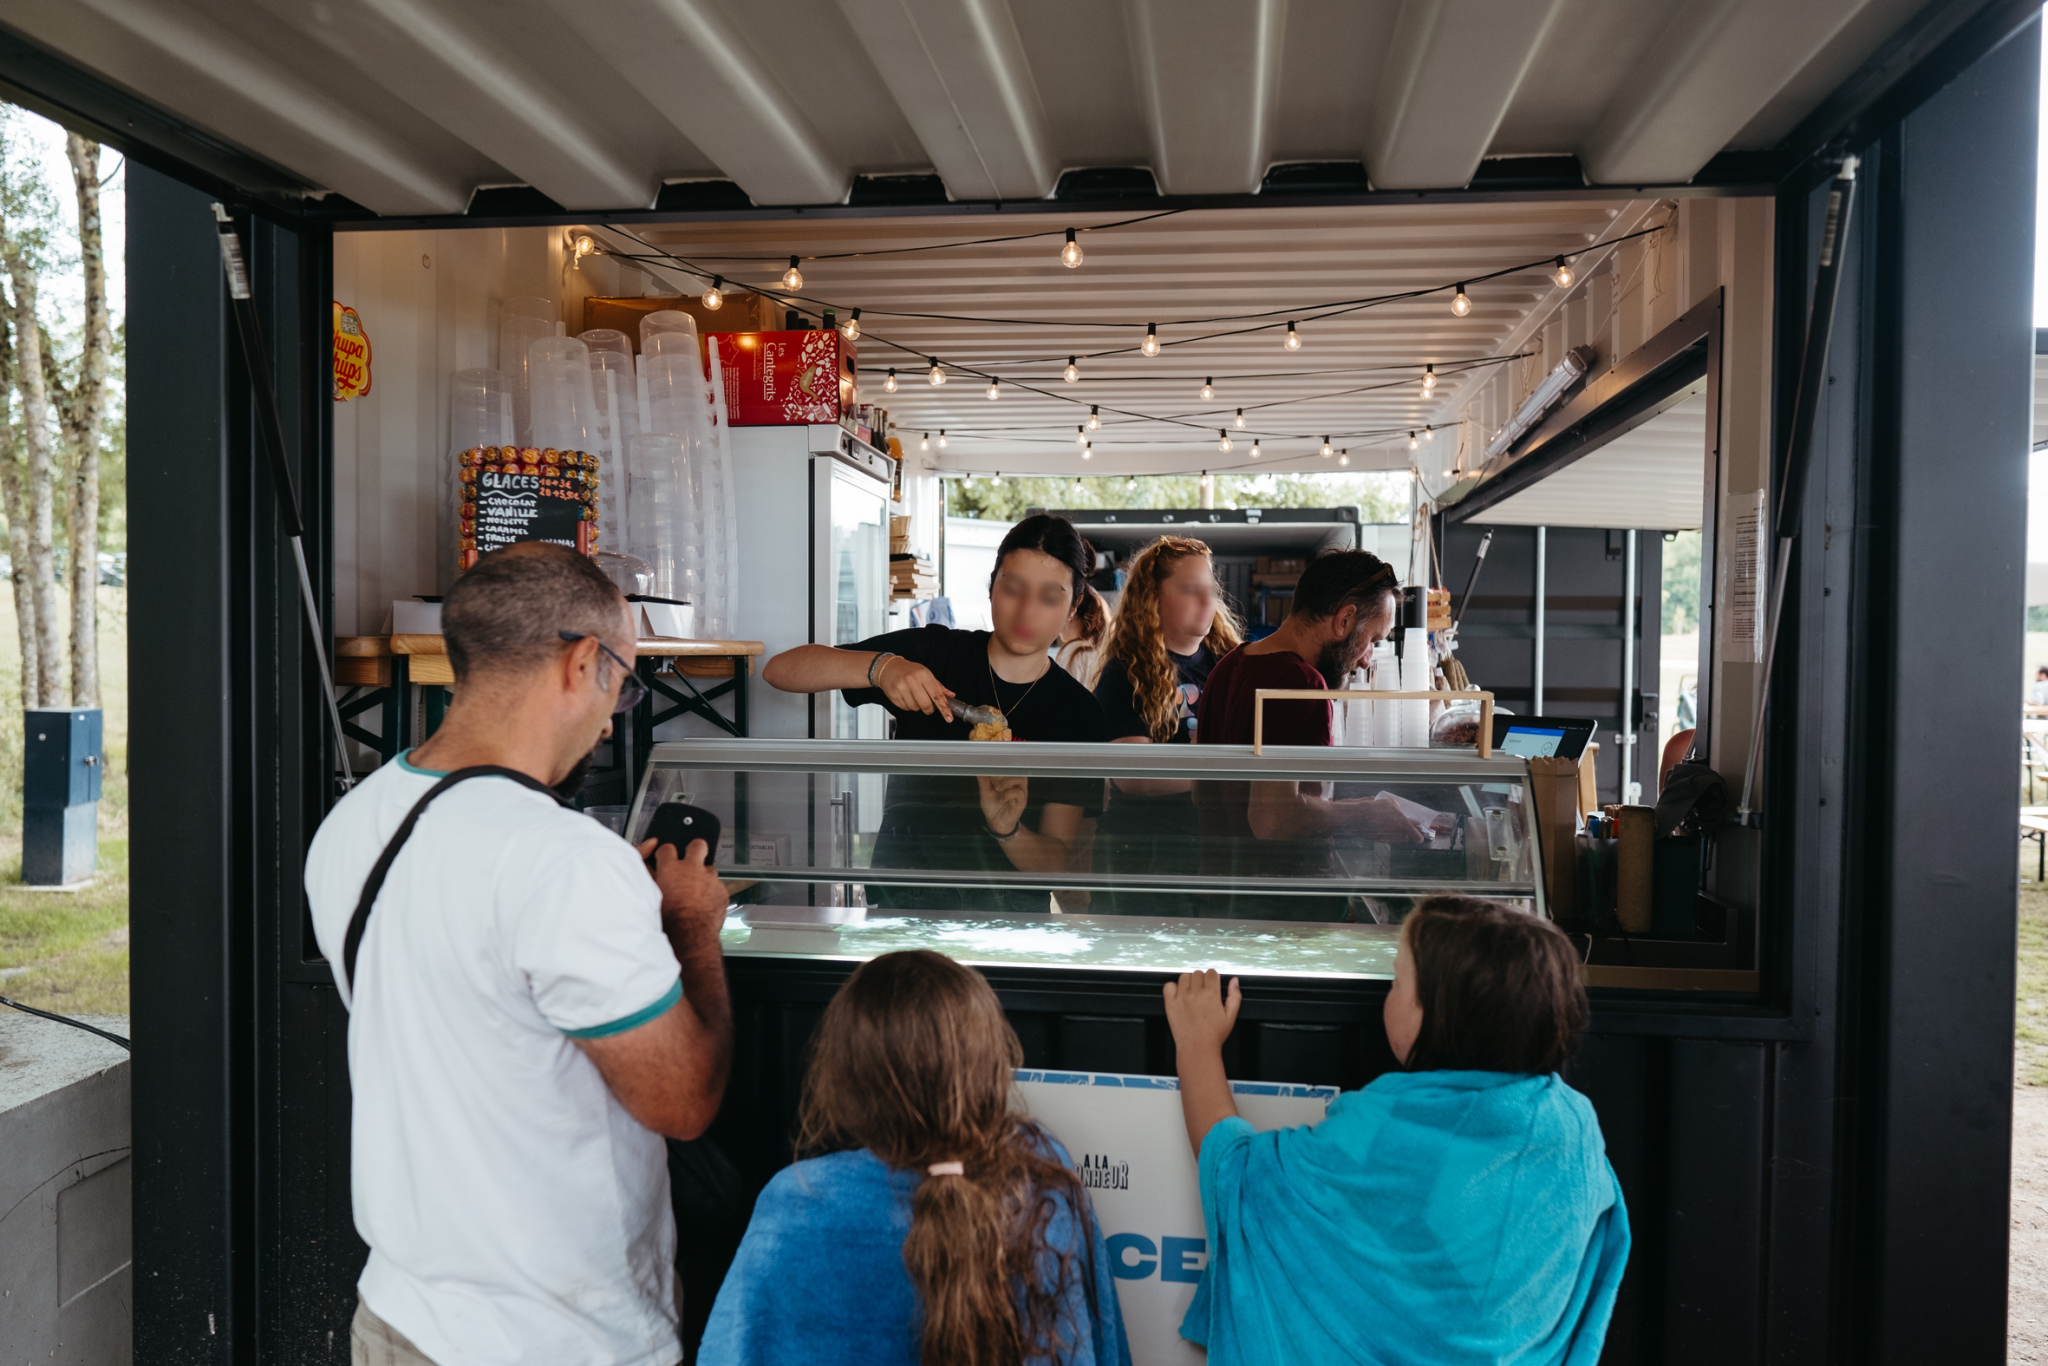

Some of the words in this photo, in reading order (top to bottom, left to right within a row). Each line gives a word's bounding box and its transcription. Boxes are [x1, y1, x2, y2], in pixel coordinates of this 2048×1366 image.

[333, 328, 364, 359] hupa
[778, 343, 787, 357] Les
[333, 351, 362, 387] hups
[763, 342, 777, 402] Cantegrits
[482, 472, 539, 489] GLACES
[1084, 1154, 1091, 1168] A
[1095, 1154, 1108, 1169] LA
